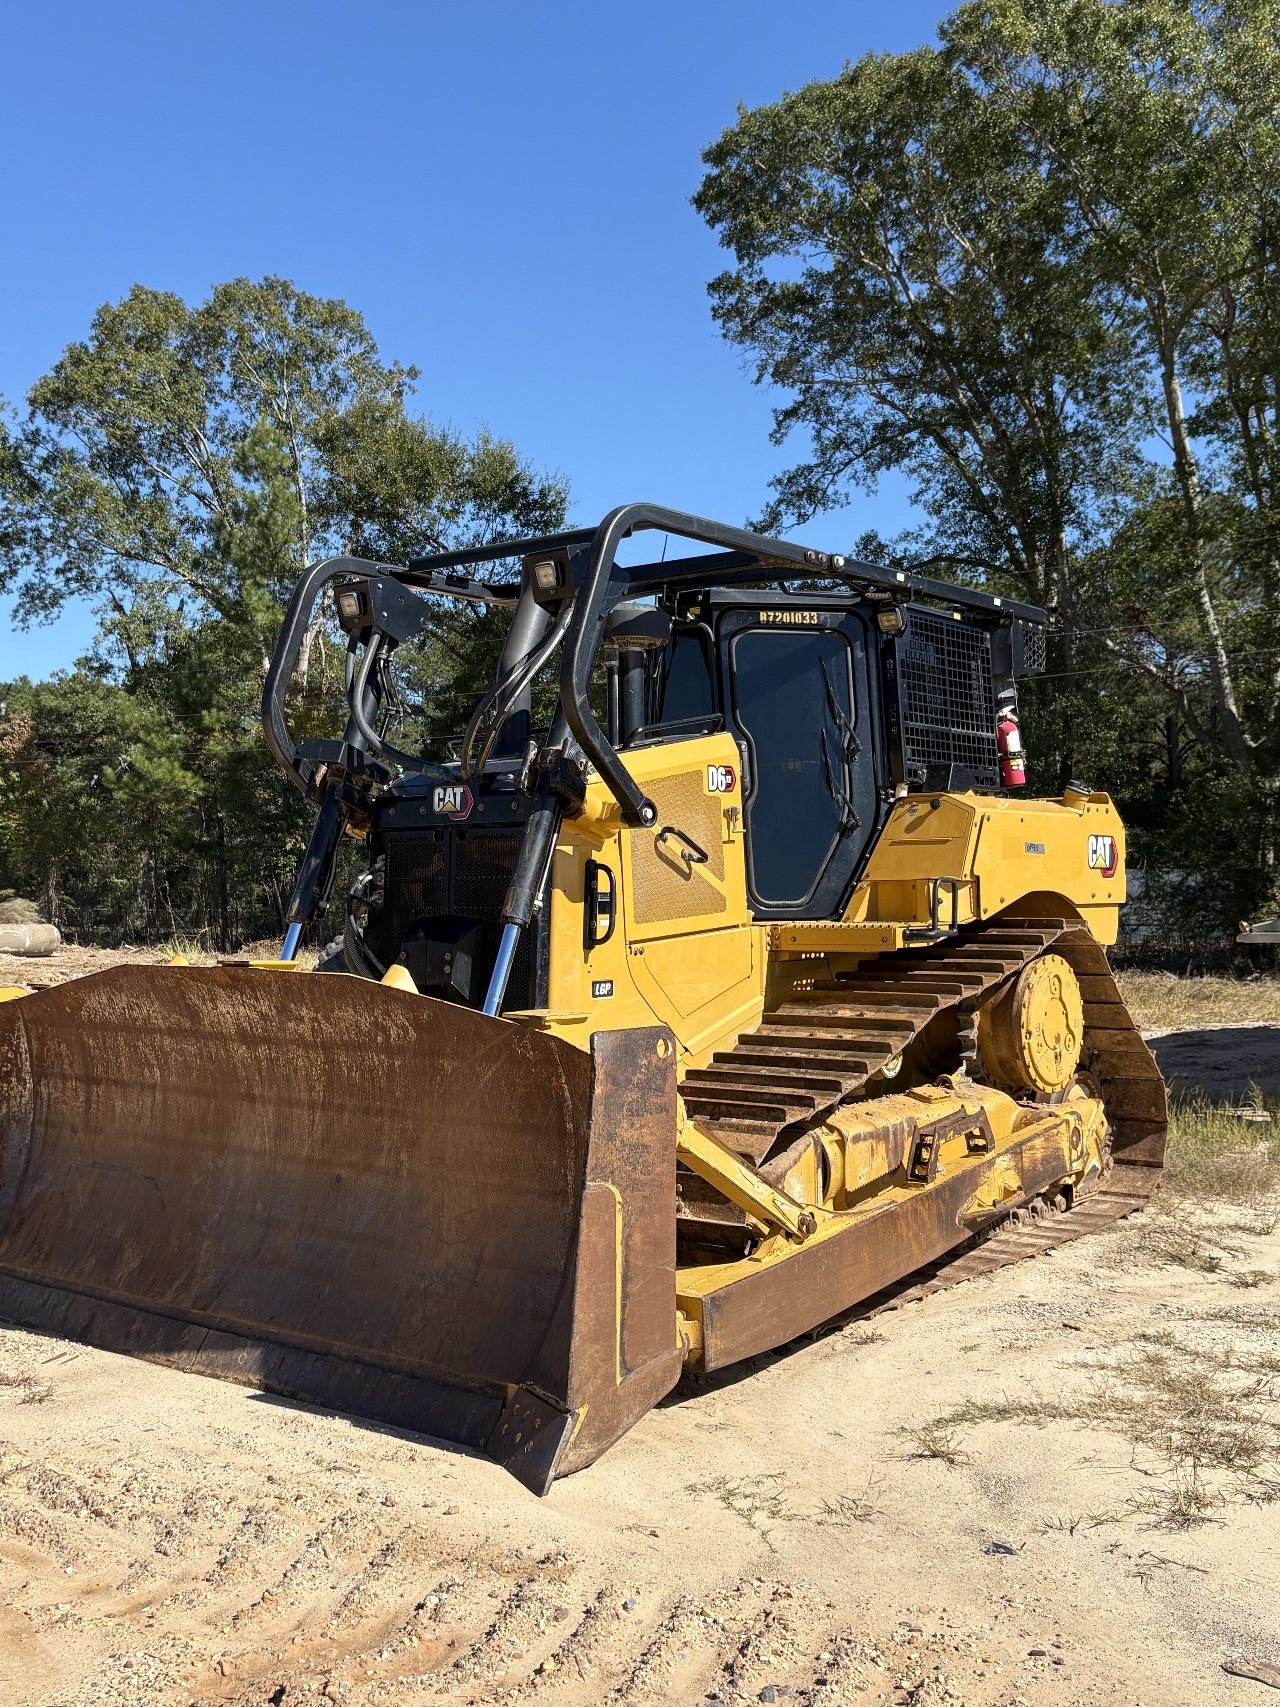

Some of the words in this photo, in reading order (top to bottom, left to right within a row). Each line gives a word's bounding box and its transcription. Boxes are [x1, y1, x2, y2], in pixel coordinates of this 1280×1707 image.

[708, 765, 726, 791] D6
[434, 787, 464, 812] CAT
[1088, 835, 1112, 868] CAT
[595, 982, 611, 995] LGP
